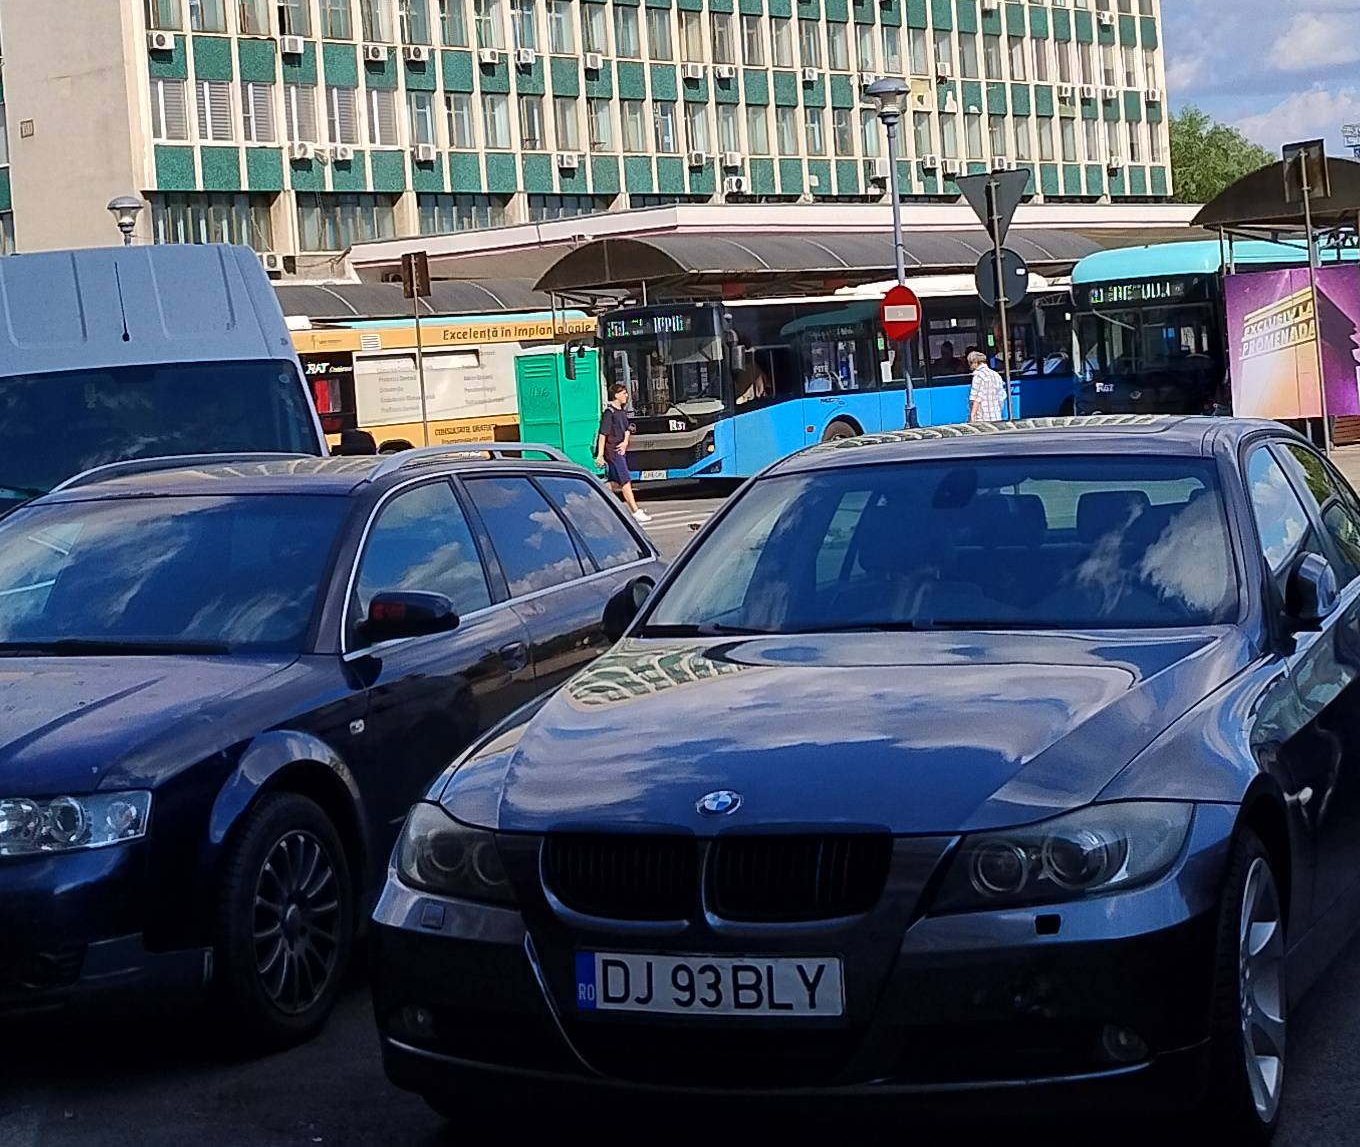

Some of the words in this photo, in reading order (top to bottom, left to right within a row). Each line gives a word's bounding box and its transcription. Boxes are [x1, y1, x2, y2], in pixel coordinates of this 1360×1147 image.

[1241, 319, 1315, 357] PROMENADA
[1244, 306, 1296, 336] EXCLUSIV
[578, 982, 595, 1002] RO
[602, 958, 654, 1005] DJ
[671, 963, 826, 1010] 93BLY
